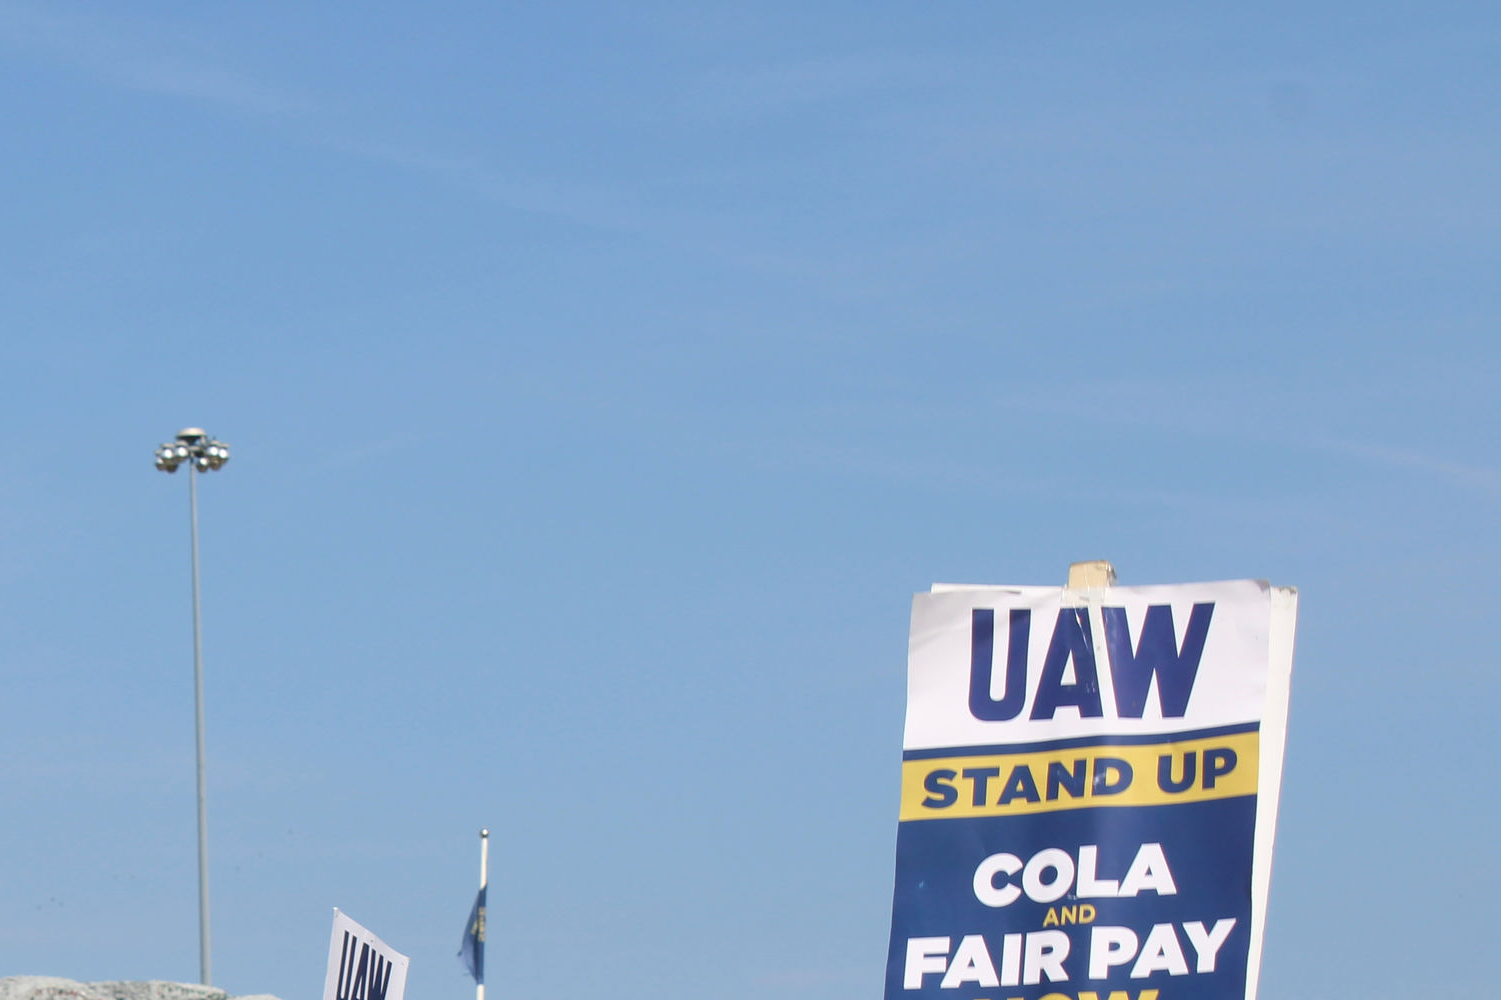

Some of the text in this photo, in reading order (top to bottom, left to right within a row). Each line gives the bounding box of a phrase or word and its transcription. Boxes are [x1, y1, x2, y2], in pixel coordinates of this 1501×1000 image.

[968, 602, 1215, 722] UAW
[922, 748, 1237, 809] STAND UP
[973, 843, 1177, 908] COLA
[1042, 904, 1096, 927] AND
[903, 918, 1237, 990] FAIR PAY
